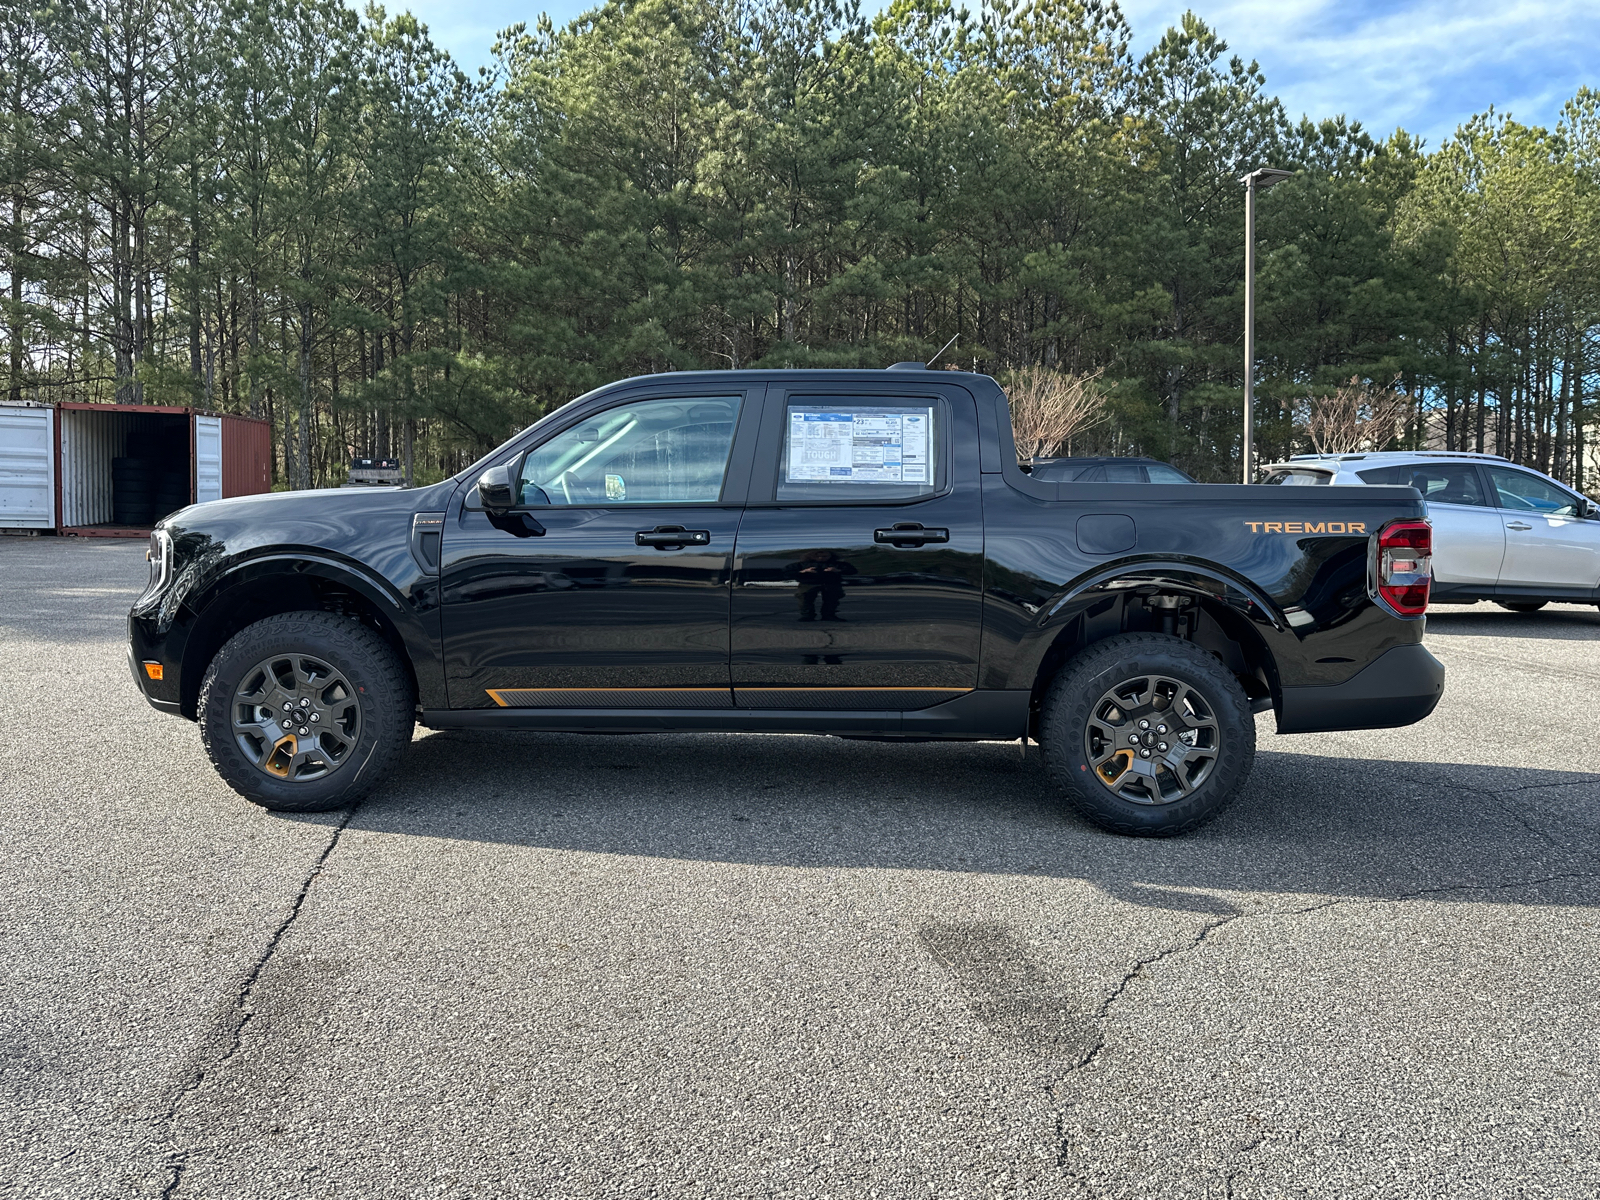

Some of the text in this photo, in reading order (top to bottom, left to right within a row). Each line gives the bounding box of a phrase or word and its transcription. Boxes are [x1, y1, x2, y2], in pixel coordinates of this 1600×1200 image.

[806, 450, 837, 459] TOUGH
[1244, 521, 1366, 534] TREMOR
[234, 636, 287, 663] TERRITORY
[213, 680, 261, 788] GOODYEAR
[327, 650, 374, 757] GOODYEAR
[1068, 661, 1140, 753] GOODYEAR
[1167, 727, 1239, 819] GOODYEAR
